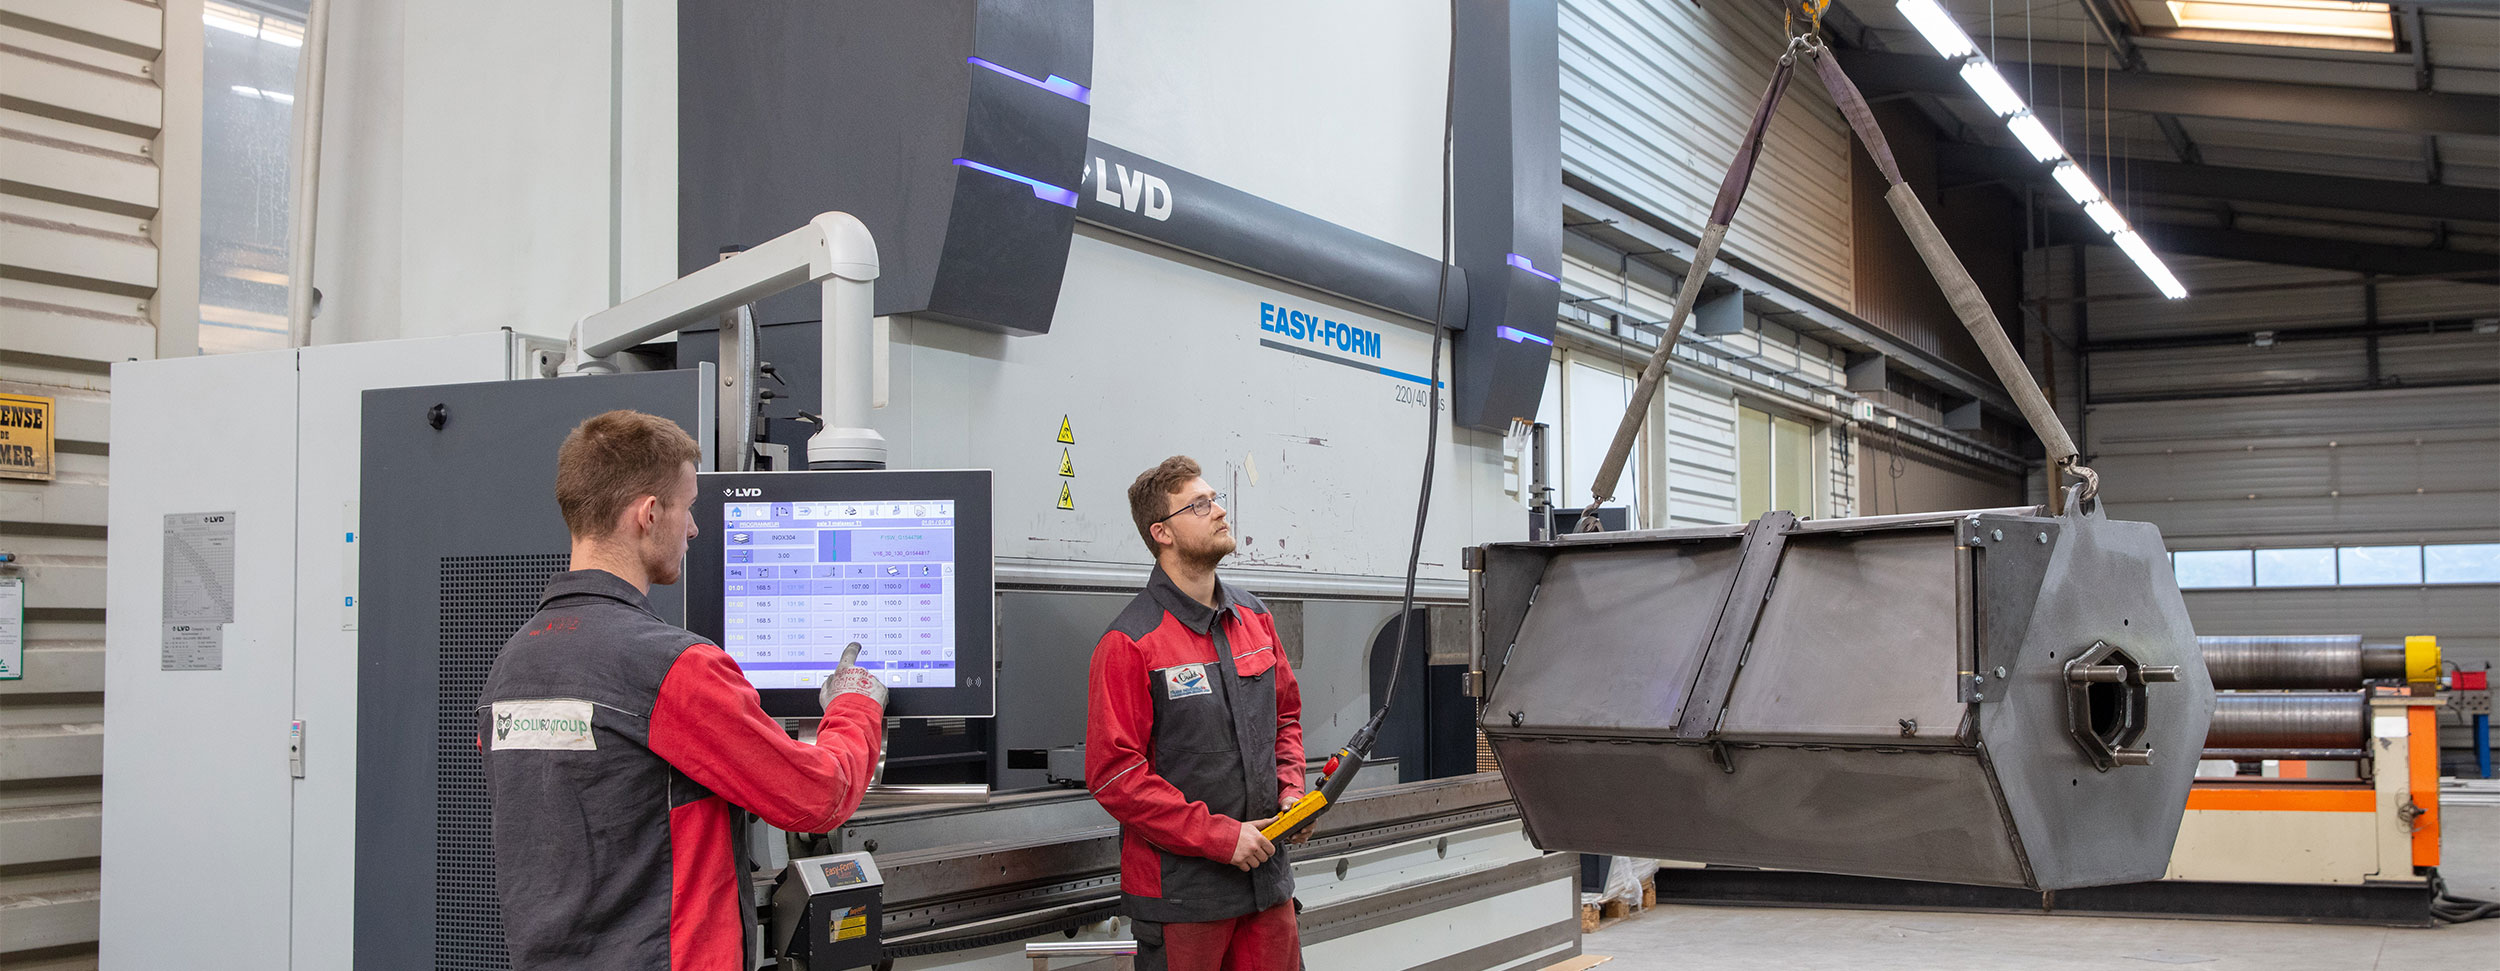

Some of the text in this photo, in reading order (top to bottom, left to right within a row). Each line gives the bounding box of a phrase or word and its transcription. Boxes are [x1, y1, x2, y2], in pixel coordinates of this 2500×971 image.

[1096, 157, 1172, 222] LVD
[1260, 302, 1381, 359] EASY-FORM
[1395, 385, 1427, 408] 220/40
[0, 405, 43, 429] ENSE
[735, 488, 762, 497] LVD
